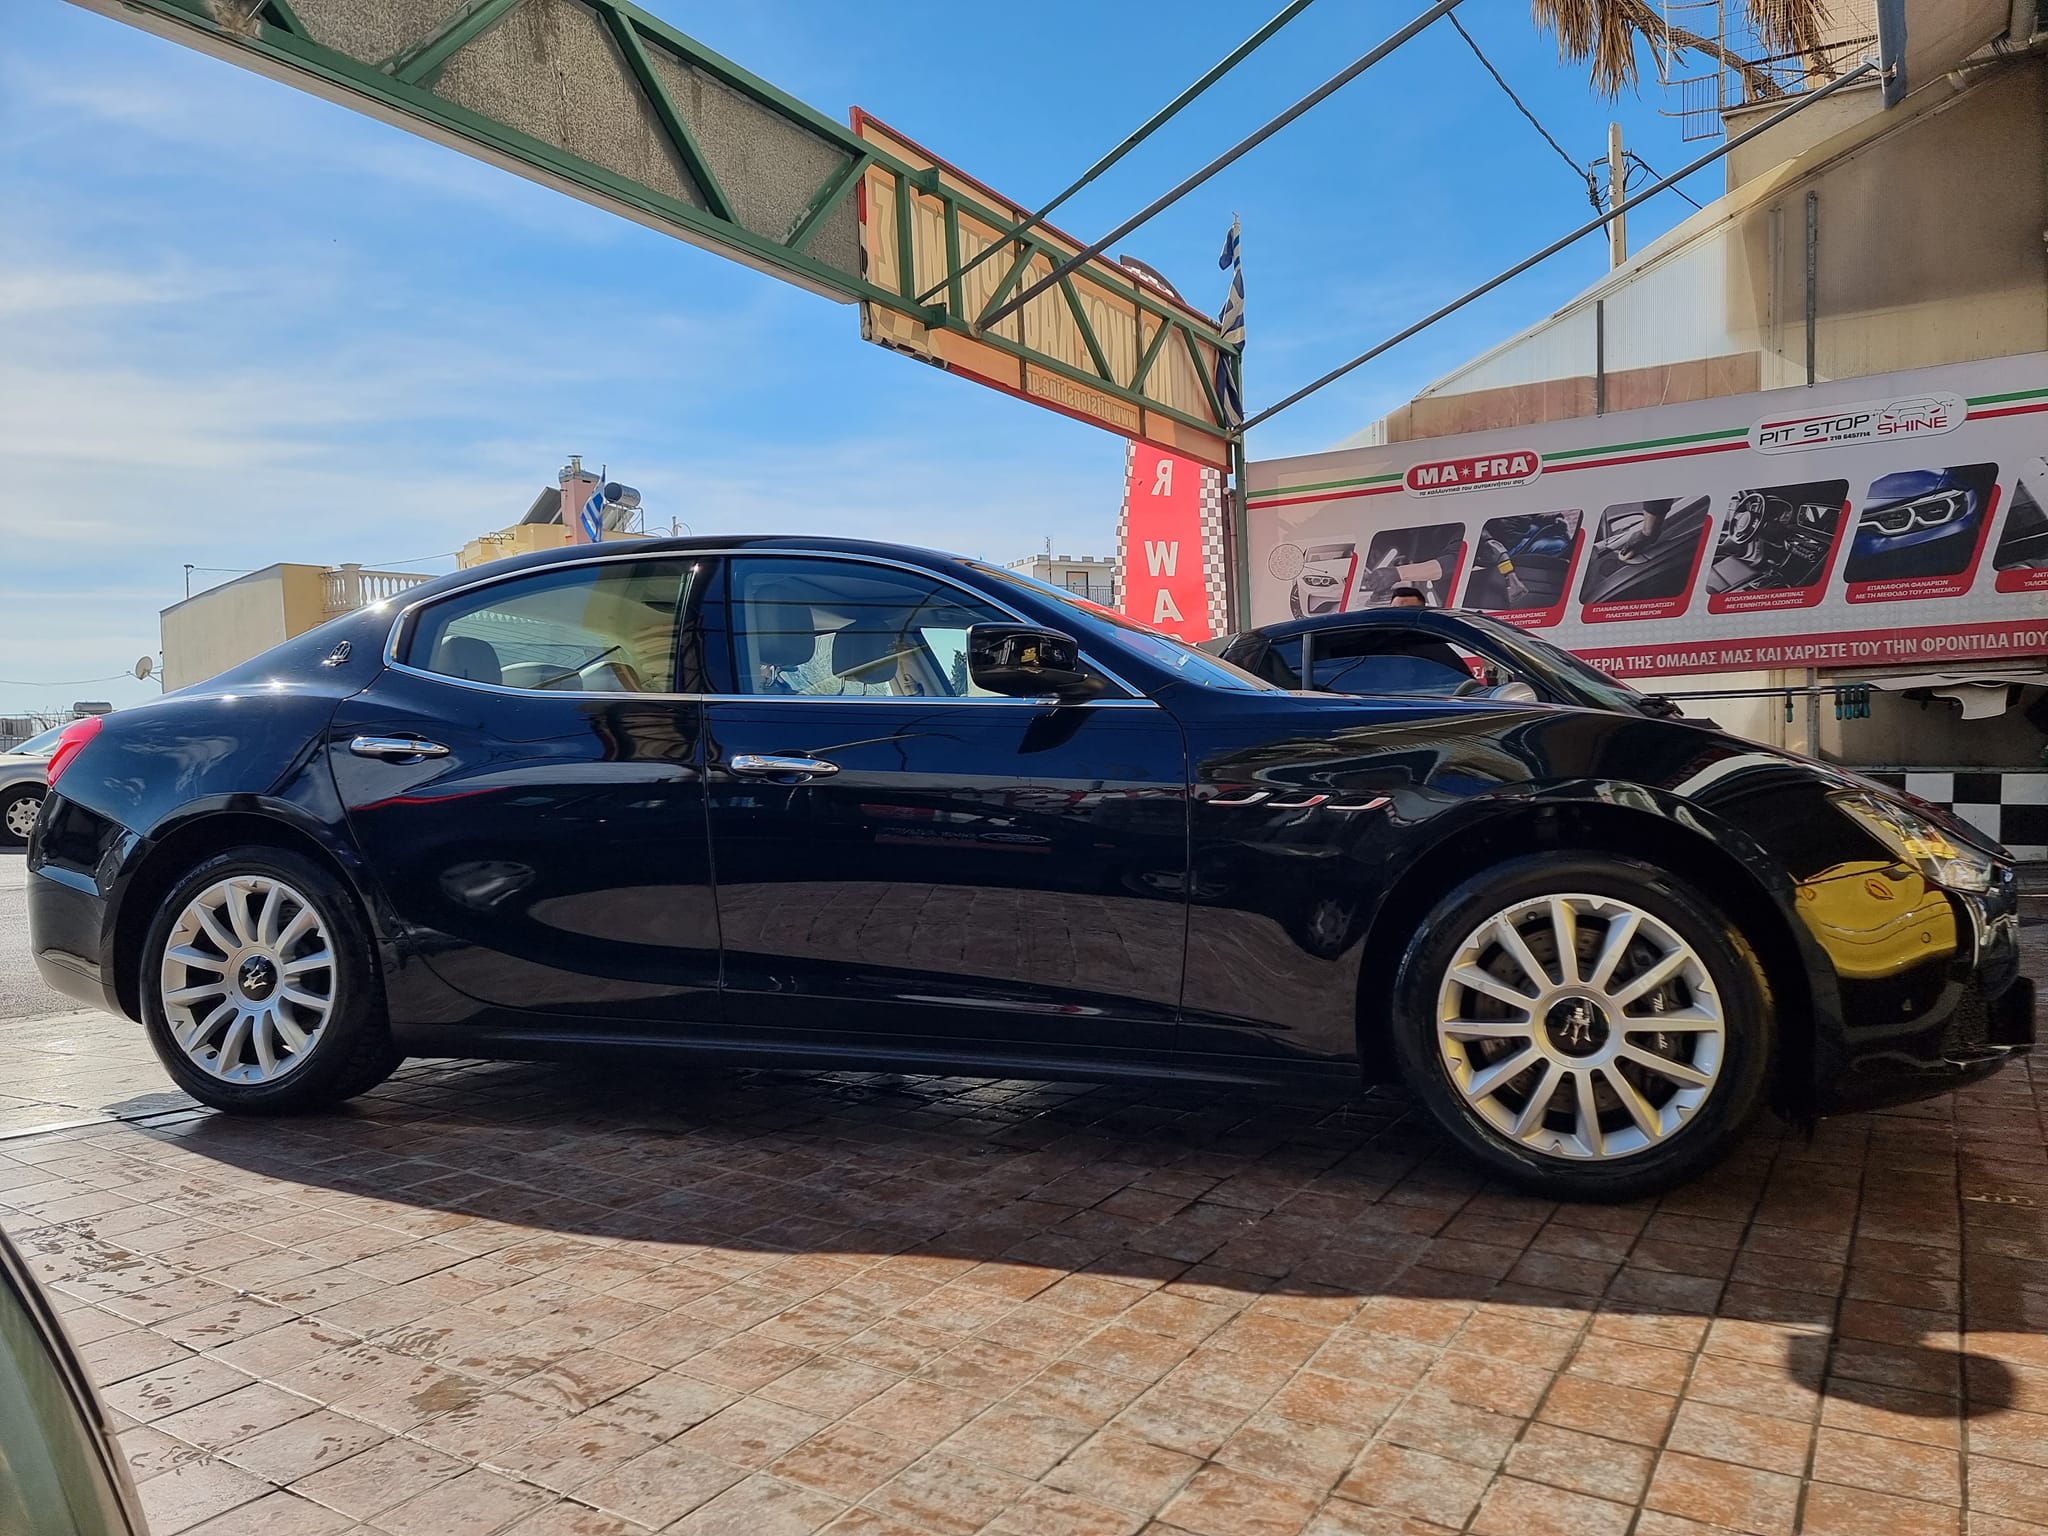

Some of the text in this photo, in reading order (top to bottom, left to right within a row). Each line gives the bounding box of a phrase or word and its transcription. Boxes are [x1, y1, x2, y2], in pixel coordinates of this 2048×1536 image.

[1759, 414, 1948, 446] PIT STOP SHINE
[1417, 455, 1529, 486] MA FRA
[1626, 655, 1654, 670] ΤΗΣ
[1656, 651, 1717, 668] ΟΜΑΔΑΣ
[1720, 648, 1753, 665] ΜΑΣ
[1757, 646, 1781, 662] ΚΑΙ
[1784, 643, 1847, 660] ΧΑΡΙΣΤΕ
[1849, 640, 1880, 657] ΤΟΥ
[1883, 637, 1917, 655] ΤΗΝ
[1921, 631, 2009, 653] ΦΡΟΝΤΙΔΑ
